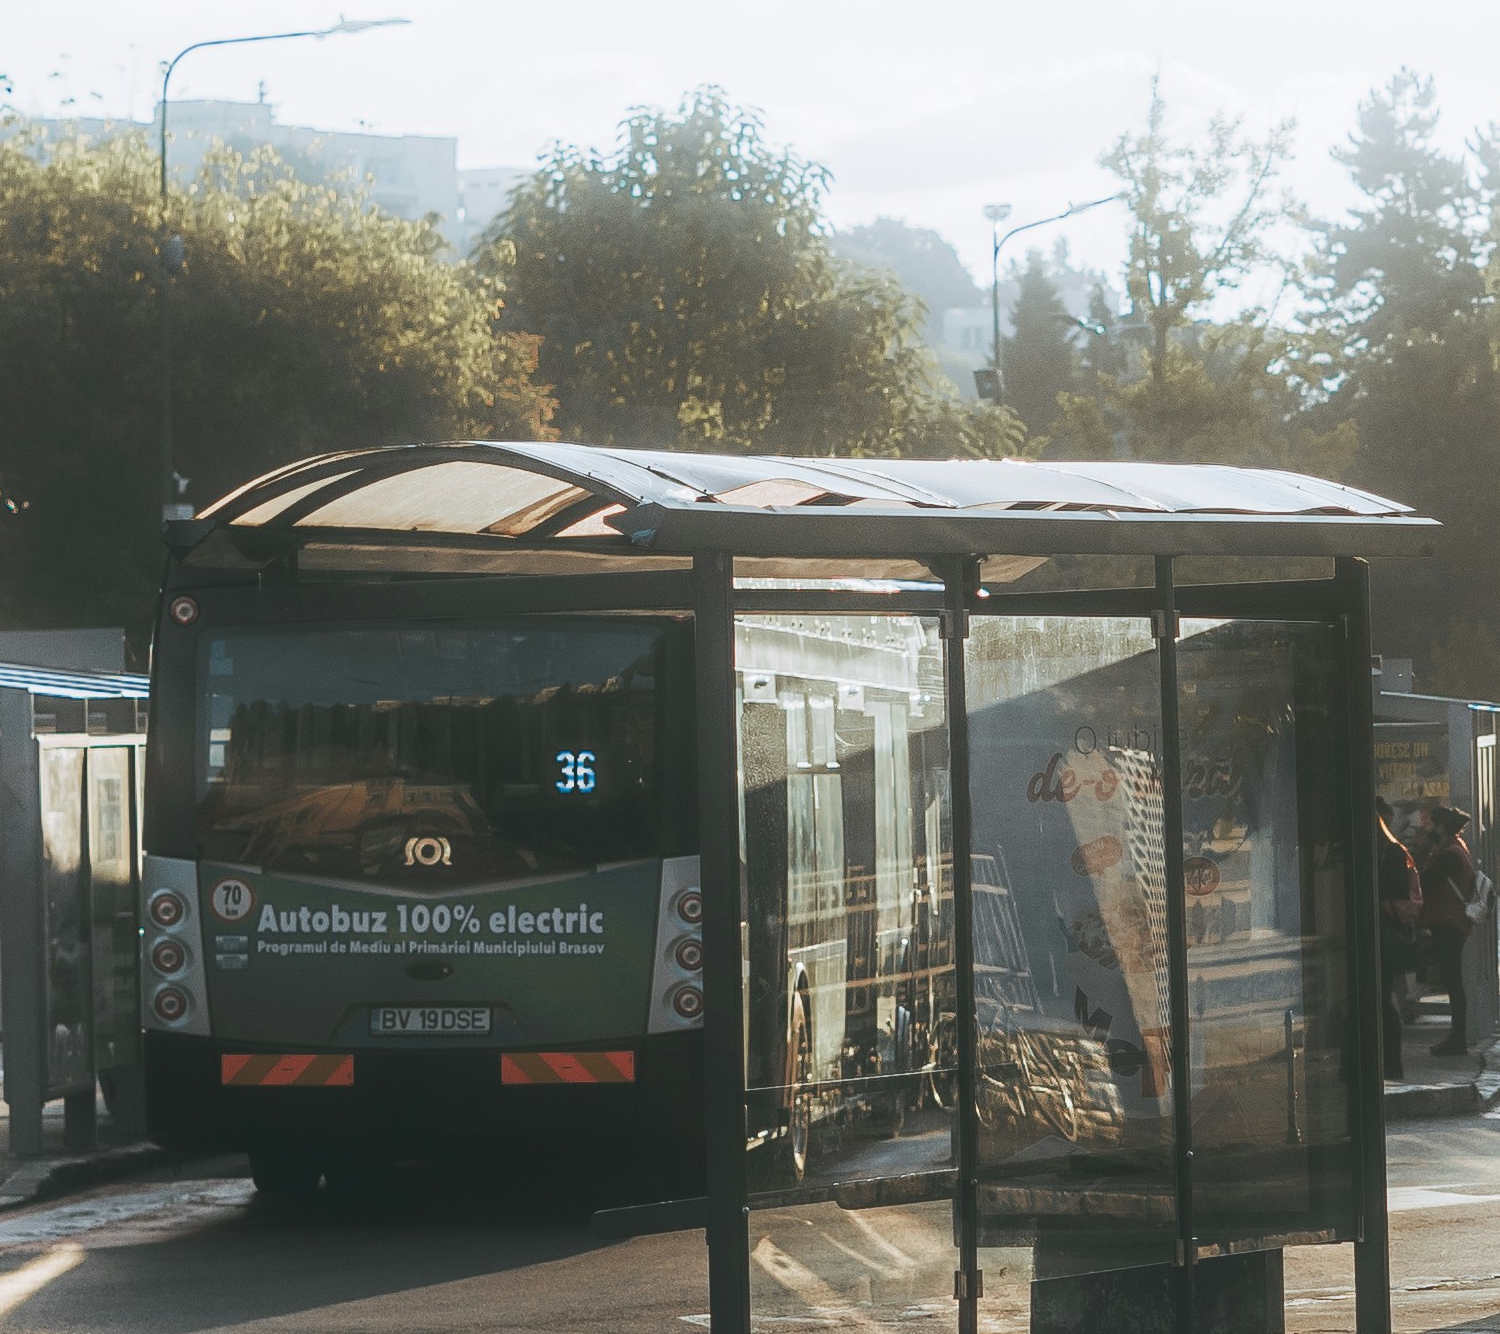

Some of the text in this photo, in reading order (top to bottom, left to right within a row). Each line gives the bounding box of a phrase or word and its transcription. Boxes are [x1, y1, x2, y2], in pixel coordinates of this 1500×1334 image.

[1107, 723, 1189, 752] iubie
[555, 751, 596, 793] 36
[222, 885, 242, 905] 70
[257, 903, 604, 935] Autobuz 100% electric
[257, 939, 327, 956] Programul
[330, 939, 347, 953] de
[350, 939, 391, 953] Mediu
[394, 939, 406, 953] al
[474, 939, 555, 957] Municipiului
[383, 1010, 412, 1029] BV
